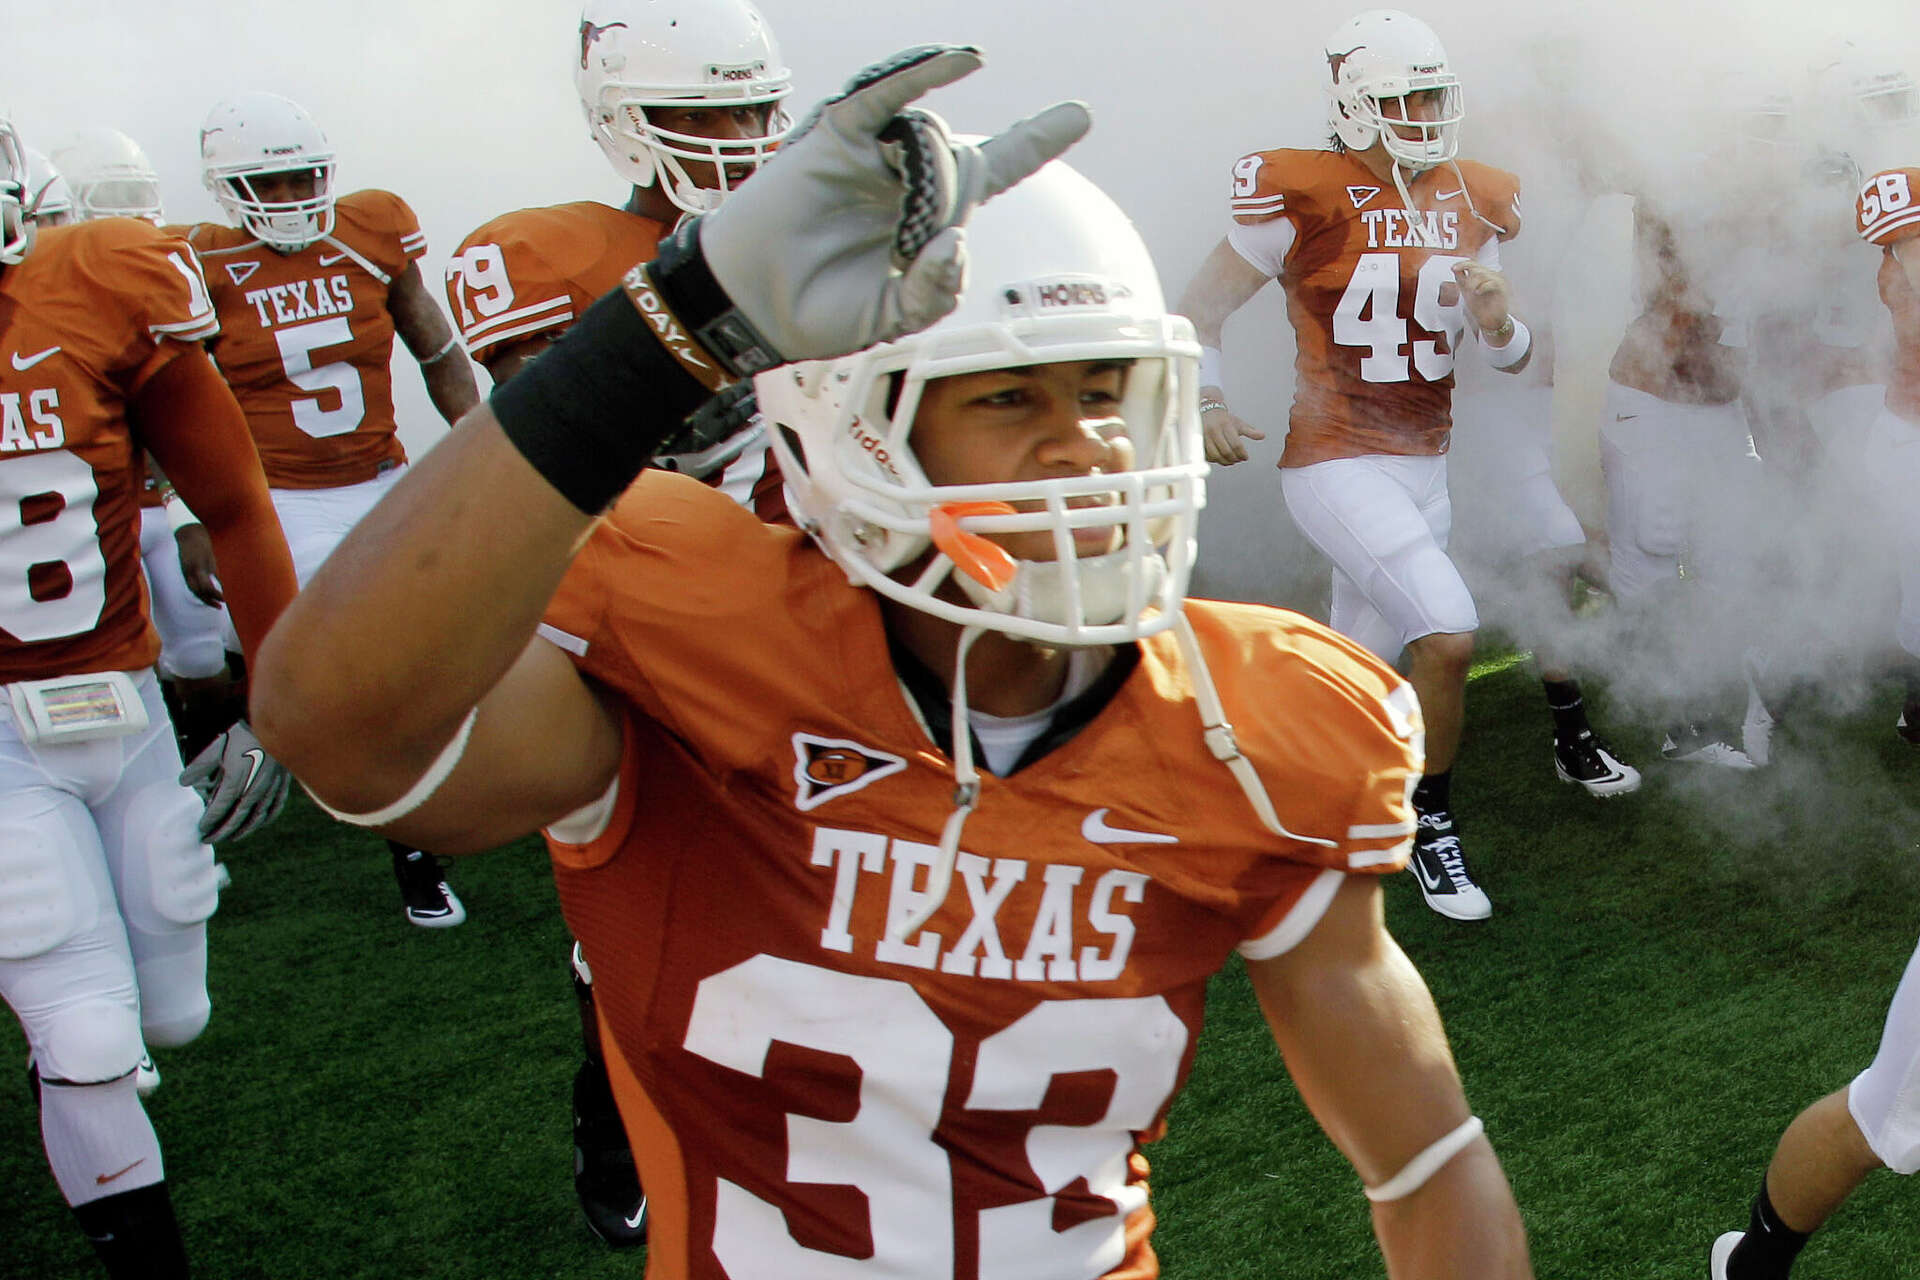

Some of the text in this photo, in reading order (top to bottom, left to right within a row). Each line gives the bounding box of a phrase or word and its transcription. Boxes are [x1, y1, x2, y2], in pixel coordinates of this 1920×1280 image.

[1361, 209, 1458, 249] TEXAS
[1860, 173, 1911, 226] 58
[246, 275, 354, 328] TEXAS
[446, 243, 515, 328] 79
[1332, 252, 1471, 383] 49
[274, 317, 366, 438] 5
[811, 827, 1151, 981] TEXAS
[682, 953, 1189, 1280] 33
